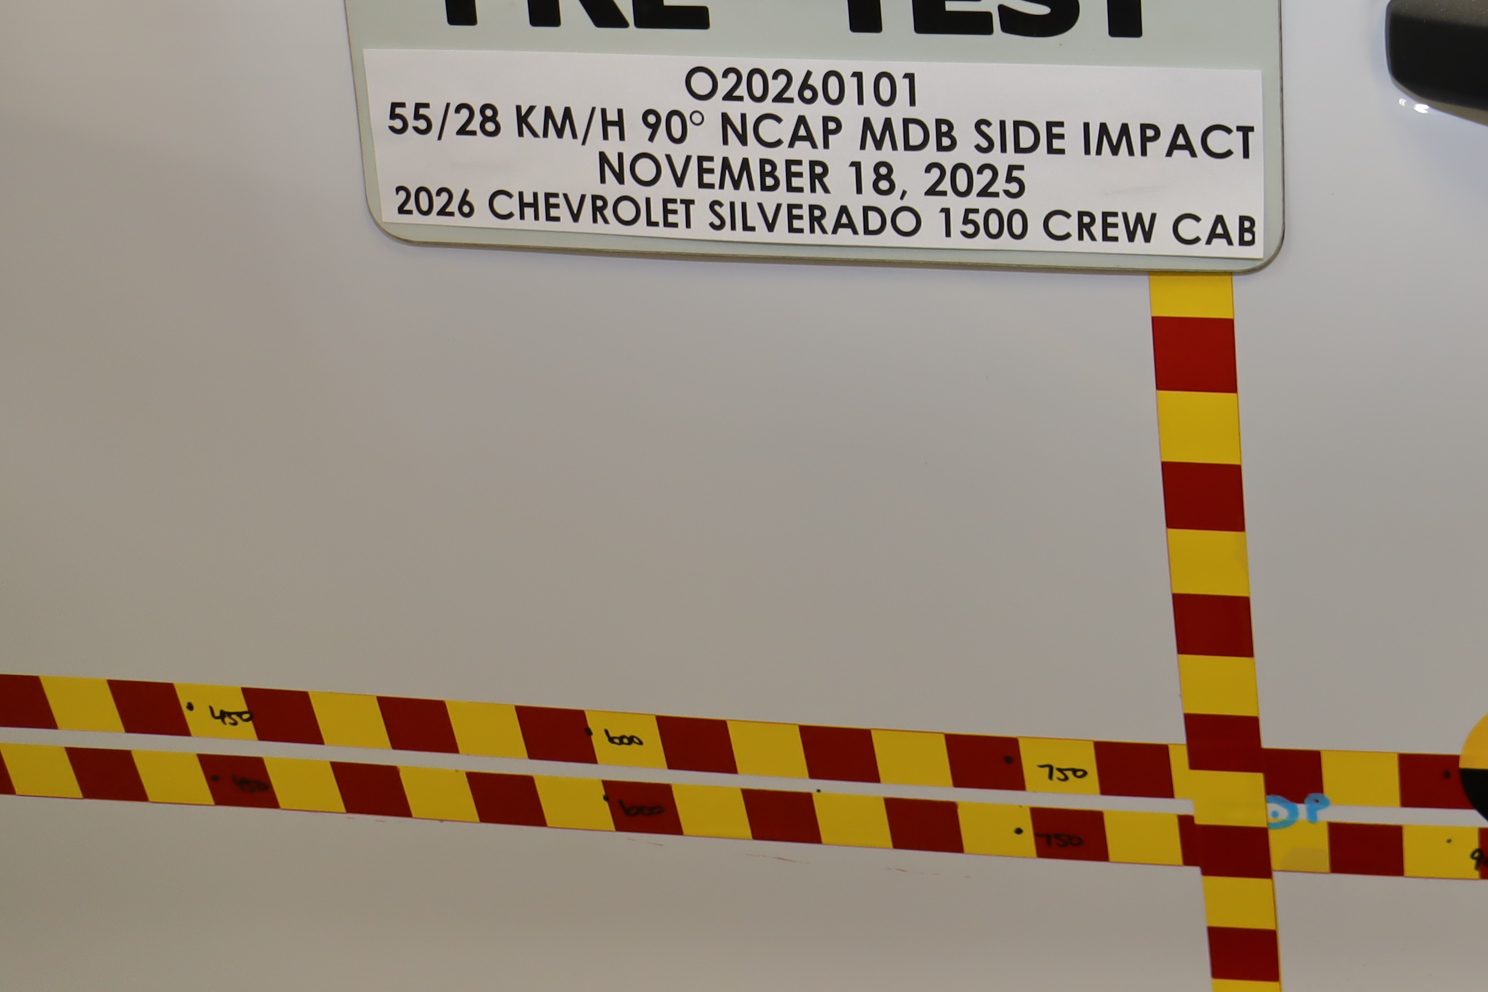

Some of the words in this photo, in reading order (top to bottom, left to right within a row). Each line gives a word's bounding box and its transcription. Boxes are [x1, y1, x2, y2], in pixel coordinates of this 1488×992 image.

[387, 101, 502, 140] 55/28
[515, 104, 626, 146] KM/H
[720, 111, 843, 150] NCAP
[859, 116, 959, 153] MDB
[973, 118, 1066, 155] SIDE
[1082, 122, 1255, 160] IMPACT
[598, 150, 831, 194] NOVEMBER
[847, 160, 906, 202] 18,
[923, 161, 1027, 200] 2025
[395, 185, 475, 219] 2026
[488, 189, 696, 229] CHEVROLET
[708, 199, 922, 239] SILVERADO
[939, 207, 1030, 241] 1500
[1042, 209, 1157, 245] CREW
[1172, 212, 1256, 247] CAB
[209, 704, 254, 726] 450
[604, 728, 643, 747] 600
[1036, 763, 1089, 783] 750
